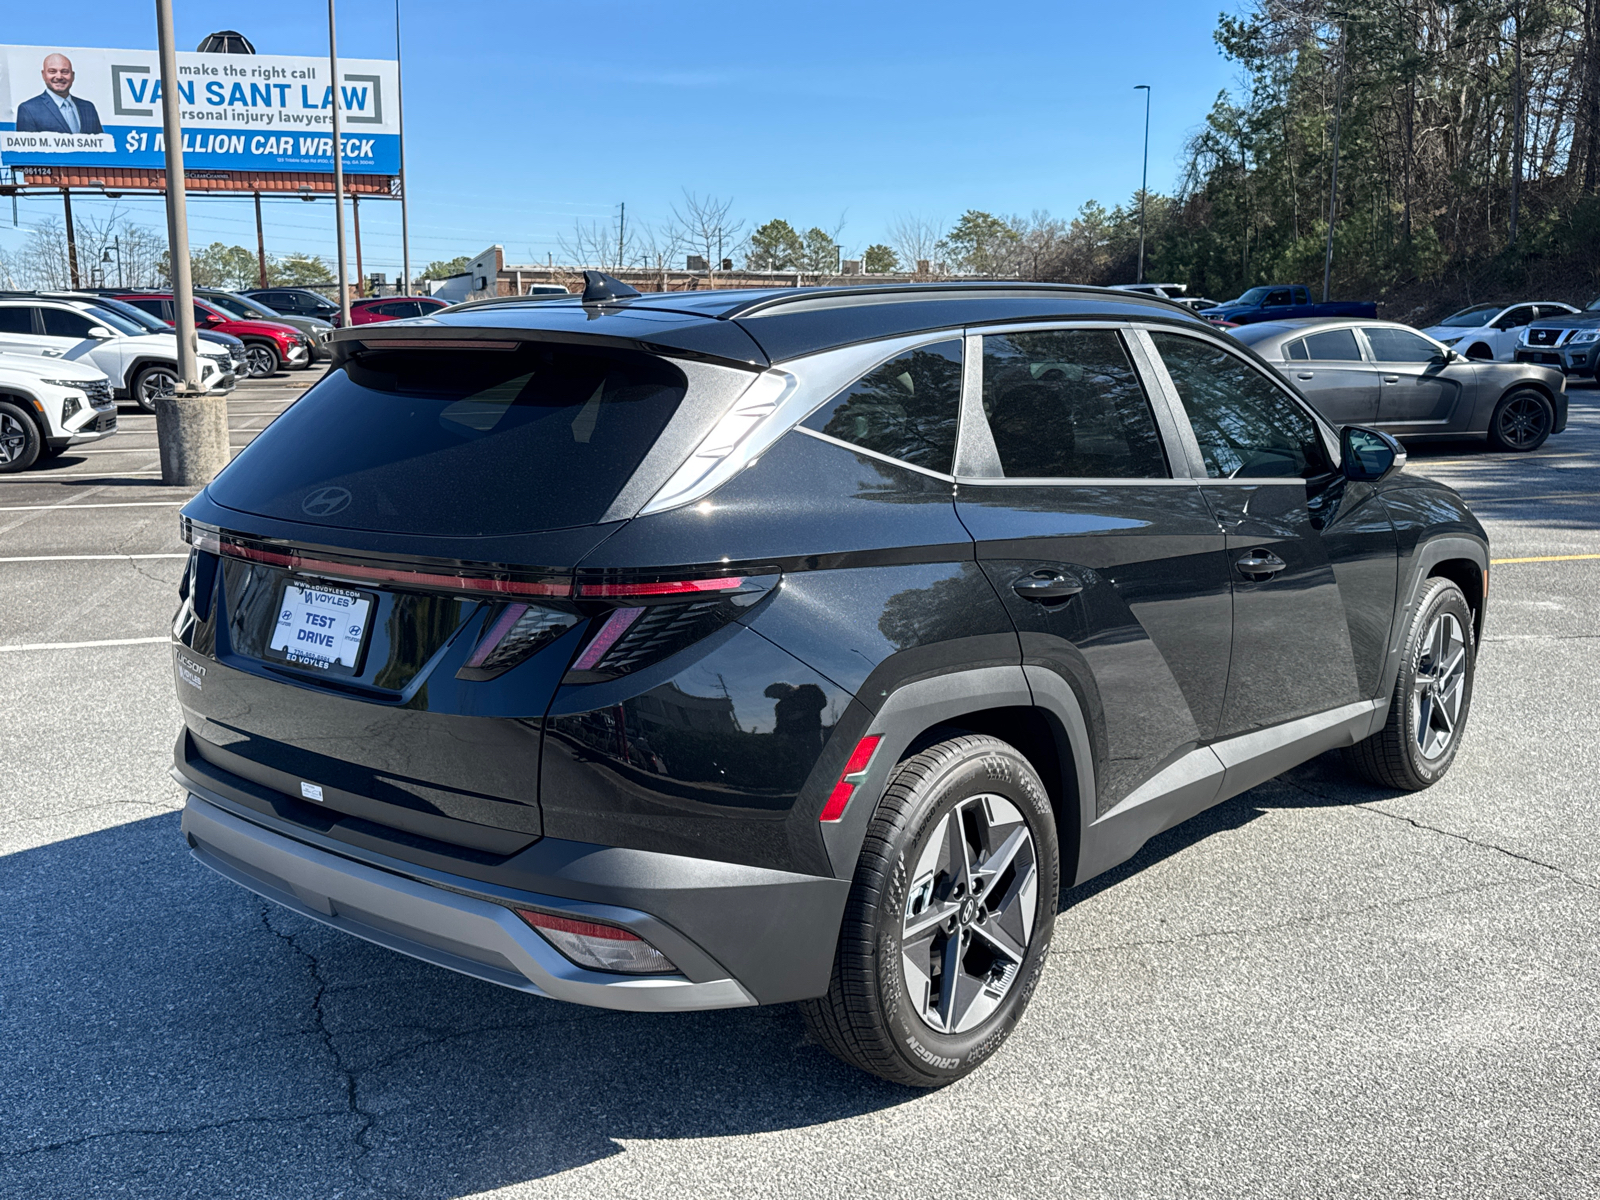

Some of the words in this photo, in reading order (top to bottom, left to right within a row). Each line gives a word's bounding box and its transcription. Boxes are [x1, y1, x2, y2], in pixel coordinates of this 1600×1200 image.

[179, 63, 219, 76] make
[223, 64, 247, 77] the
[251, 65, 287, 81] right
[291, 67, 316, 79] call
[205, 81, 292, 108] SANT
[231, 108, 274, 126] injury
[6, 137, 37, 147] DAVID
[39, 138, 51, 147] M.
[53, 138, 75, 148] VAN
[77, 138, 104, 148] SANT
[125, 129, 148, 154] $1
[250, 135, 294, 156] CAR
[314, 592, 350, 608] VOYLES
[305, 612, 336, 629] TEST
[296, 628, 335, 648] DRIVE
[286, 653, 297, 662] ED
[299, 656, 330, 670] VOYLES
[905, 1035, 960, 1070] CRUGEN
